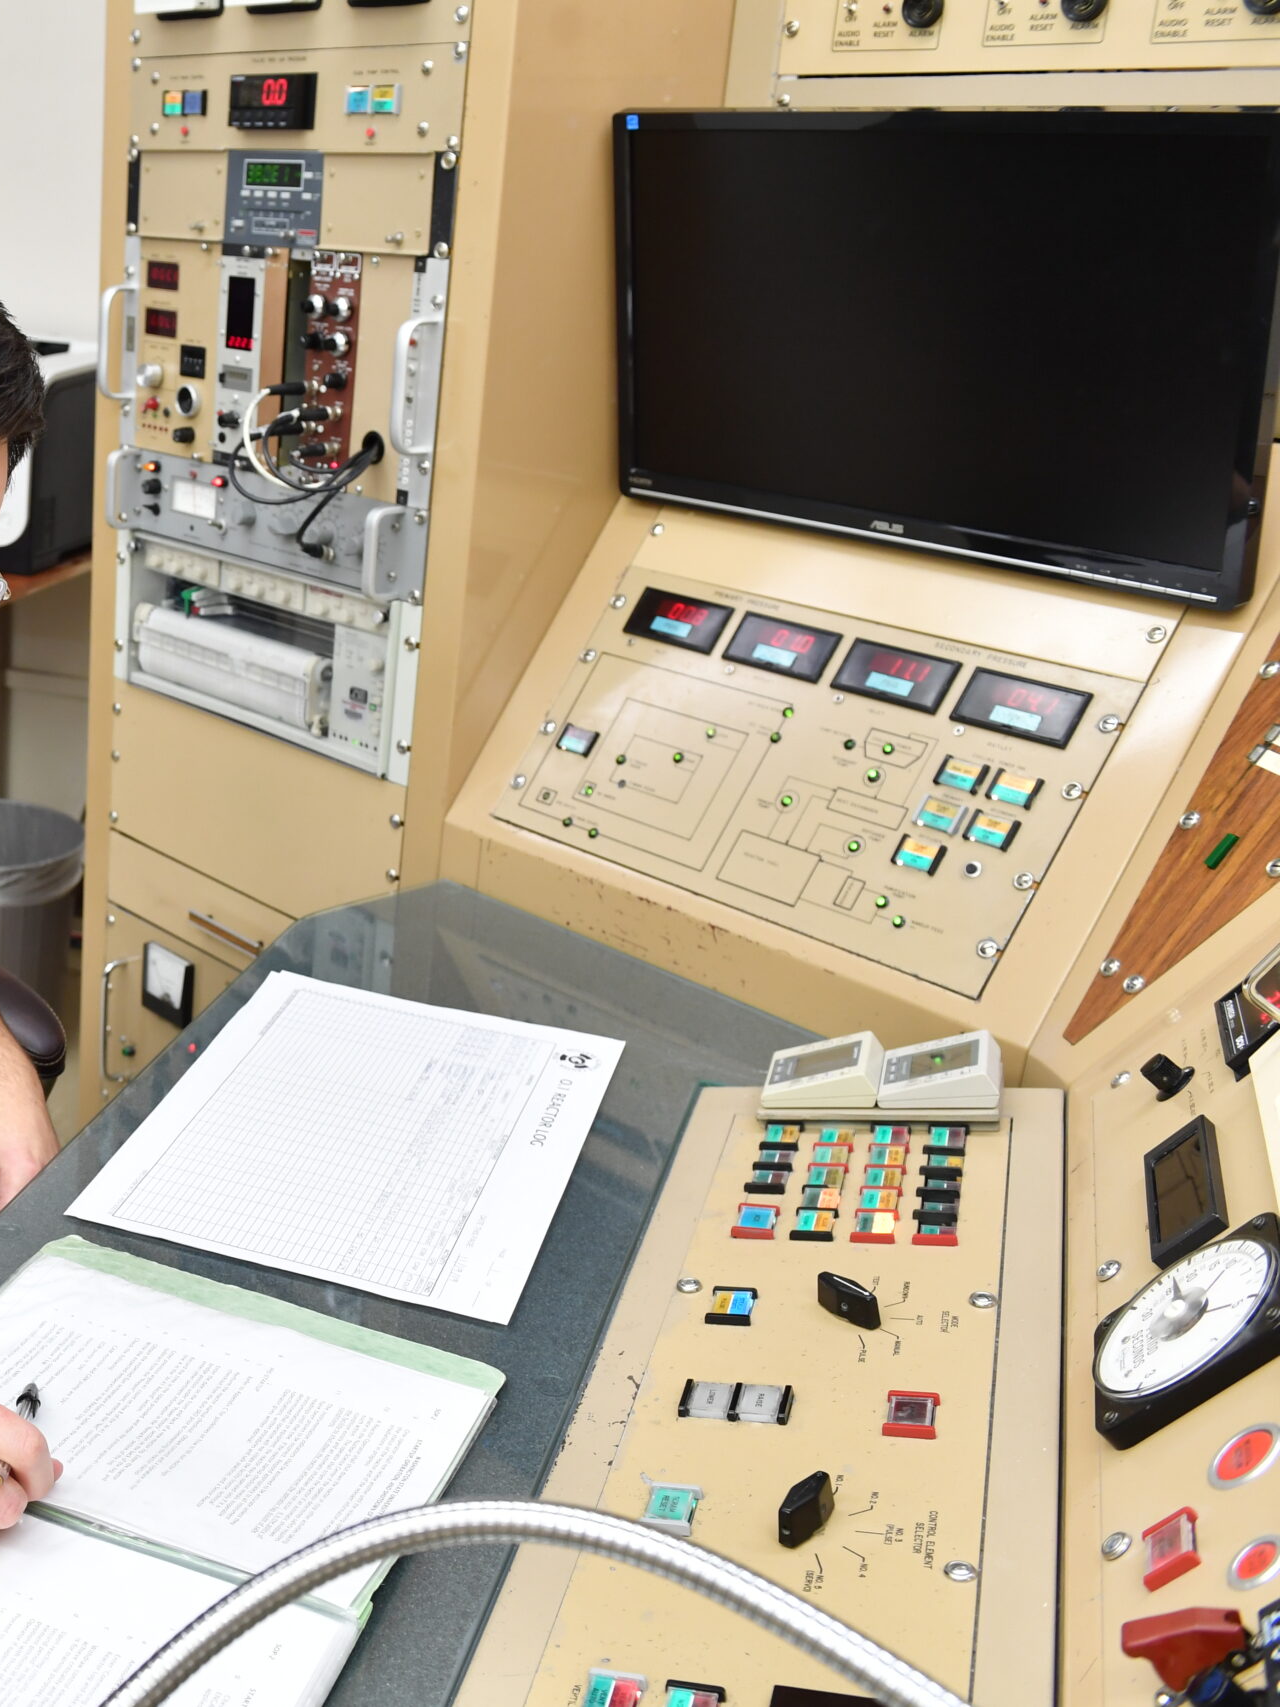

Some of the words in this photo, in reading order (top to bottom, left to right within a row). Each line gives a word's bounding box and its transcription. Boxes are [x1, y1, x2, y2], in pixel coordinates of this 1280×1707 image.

[1204, 6, 1238, 16] ALARM
[989, 24, 1015, 32] AUDIO
[1158, 18, 1188, 27] AUDIO
[1204, 18, 1234, 26] RESET
[1154, 29, 1188, 38] ENABLE
[870, 520, 904, 534] ASUS
[935, 642, 982, 656] SECONDARY
[986, 653, 1028, 668] PRESSURE
[538, 1091, 567, 1130] REACTOR
[530, 1129, 550, 1148] LOG
[858, 1350, 867, 1363] PULSE
[1132, 1329, 1145, 1369] SECONDS
[706, 1390, 716, 1404] LOWER
[755, 1393, 765, 1407] RAISE
[658, 1495, 670, 1512] RESET
[670, 1496, 680, 1512] SCRAM
[926, 1510, 938, 1538] CONTROL
[884, 1524, 895, 1545] (PULSE)
[912, 1522, 924, 1554] SELECTOR
[924, 1540, 935, 1569] ELEMENT
[802, 1570, 814, 1592] (SERVO)
[590, 1687, 599, 1704] AUTO
[599, 1688, 608, 1705] VENT
